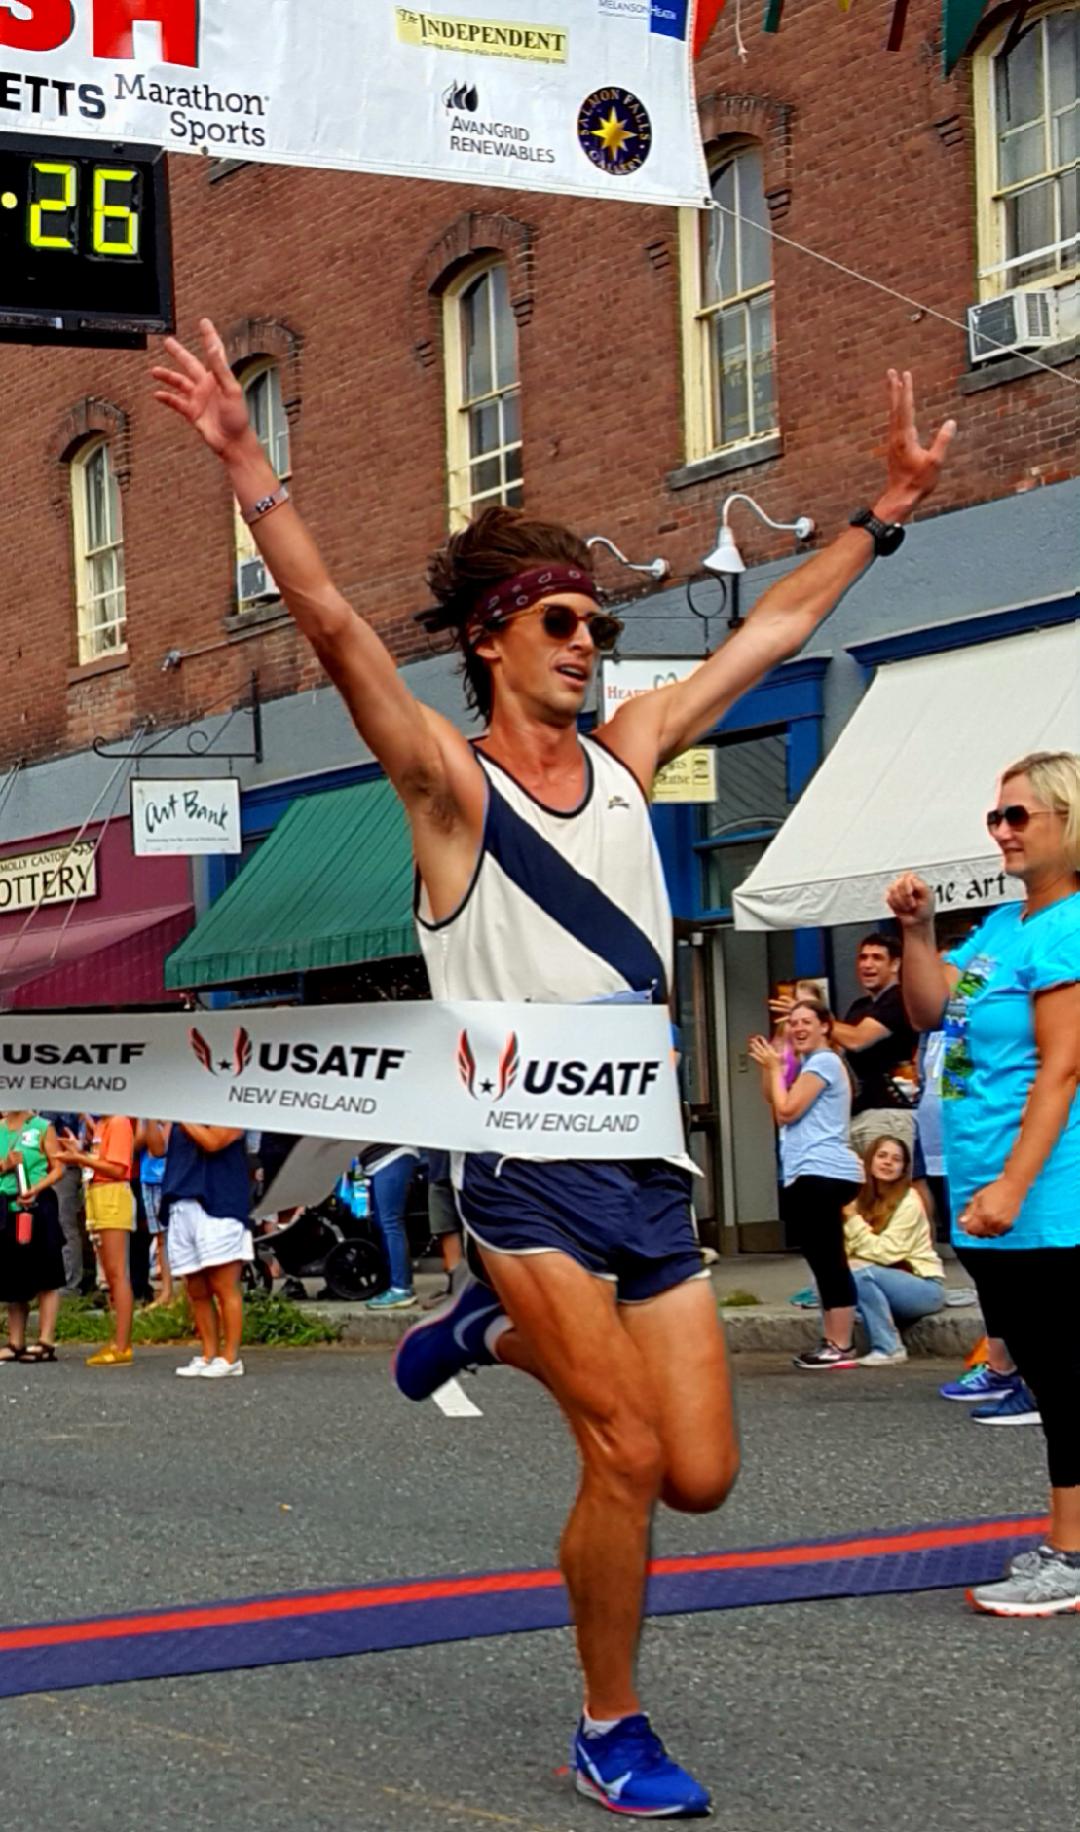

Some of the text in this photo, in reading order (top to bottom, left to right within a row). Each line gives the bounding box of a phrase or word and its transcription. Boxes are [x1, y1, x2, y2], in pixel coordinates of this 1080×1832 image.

[418, 14, 566, 51] INDEPENDENT
[0, 71, 106, 119] ETTS
[114, 73, 266, 116] Marathon
[170, 110, 266, 147] Sports
[450, 115, 531, 142] AVANGRID
[622, 94, 650, 140] FALLS
[450, 135, 556, 164] RENEWABLES
[182, 789, 228, 831] Bank
[0, 865, 92, 907] OTTERY
[966, 872, 1006, 899] art
[2, 1042, 149, 1065] USATF
[258, 1043, 411, 1081] USATF
[30, 1075, 127, 1092] ENGLAND
[522, 1059, 662, 1097] USATF
[227, 1085, 378, 1115] NEW ENGLAND
[485, 1109, 641, 1133] NEW ENGLAND
